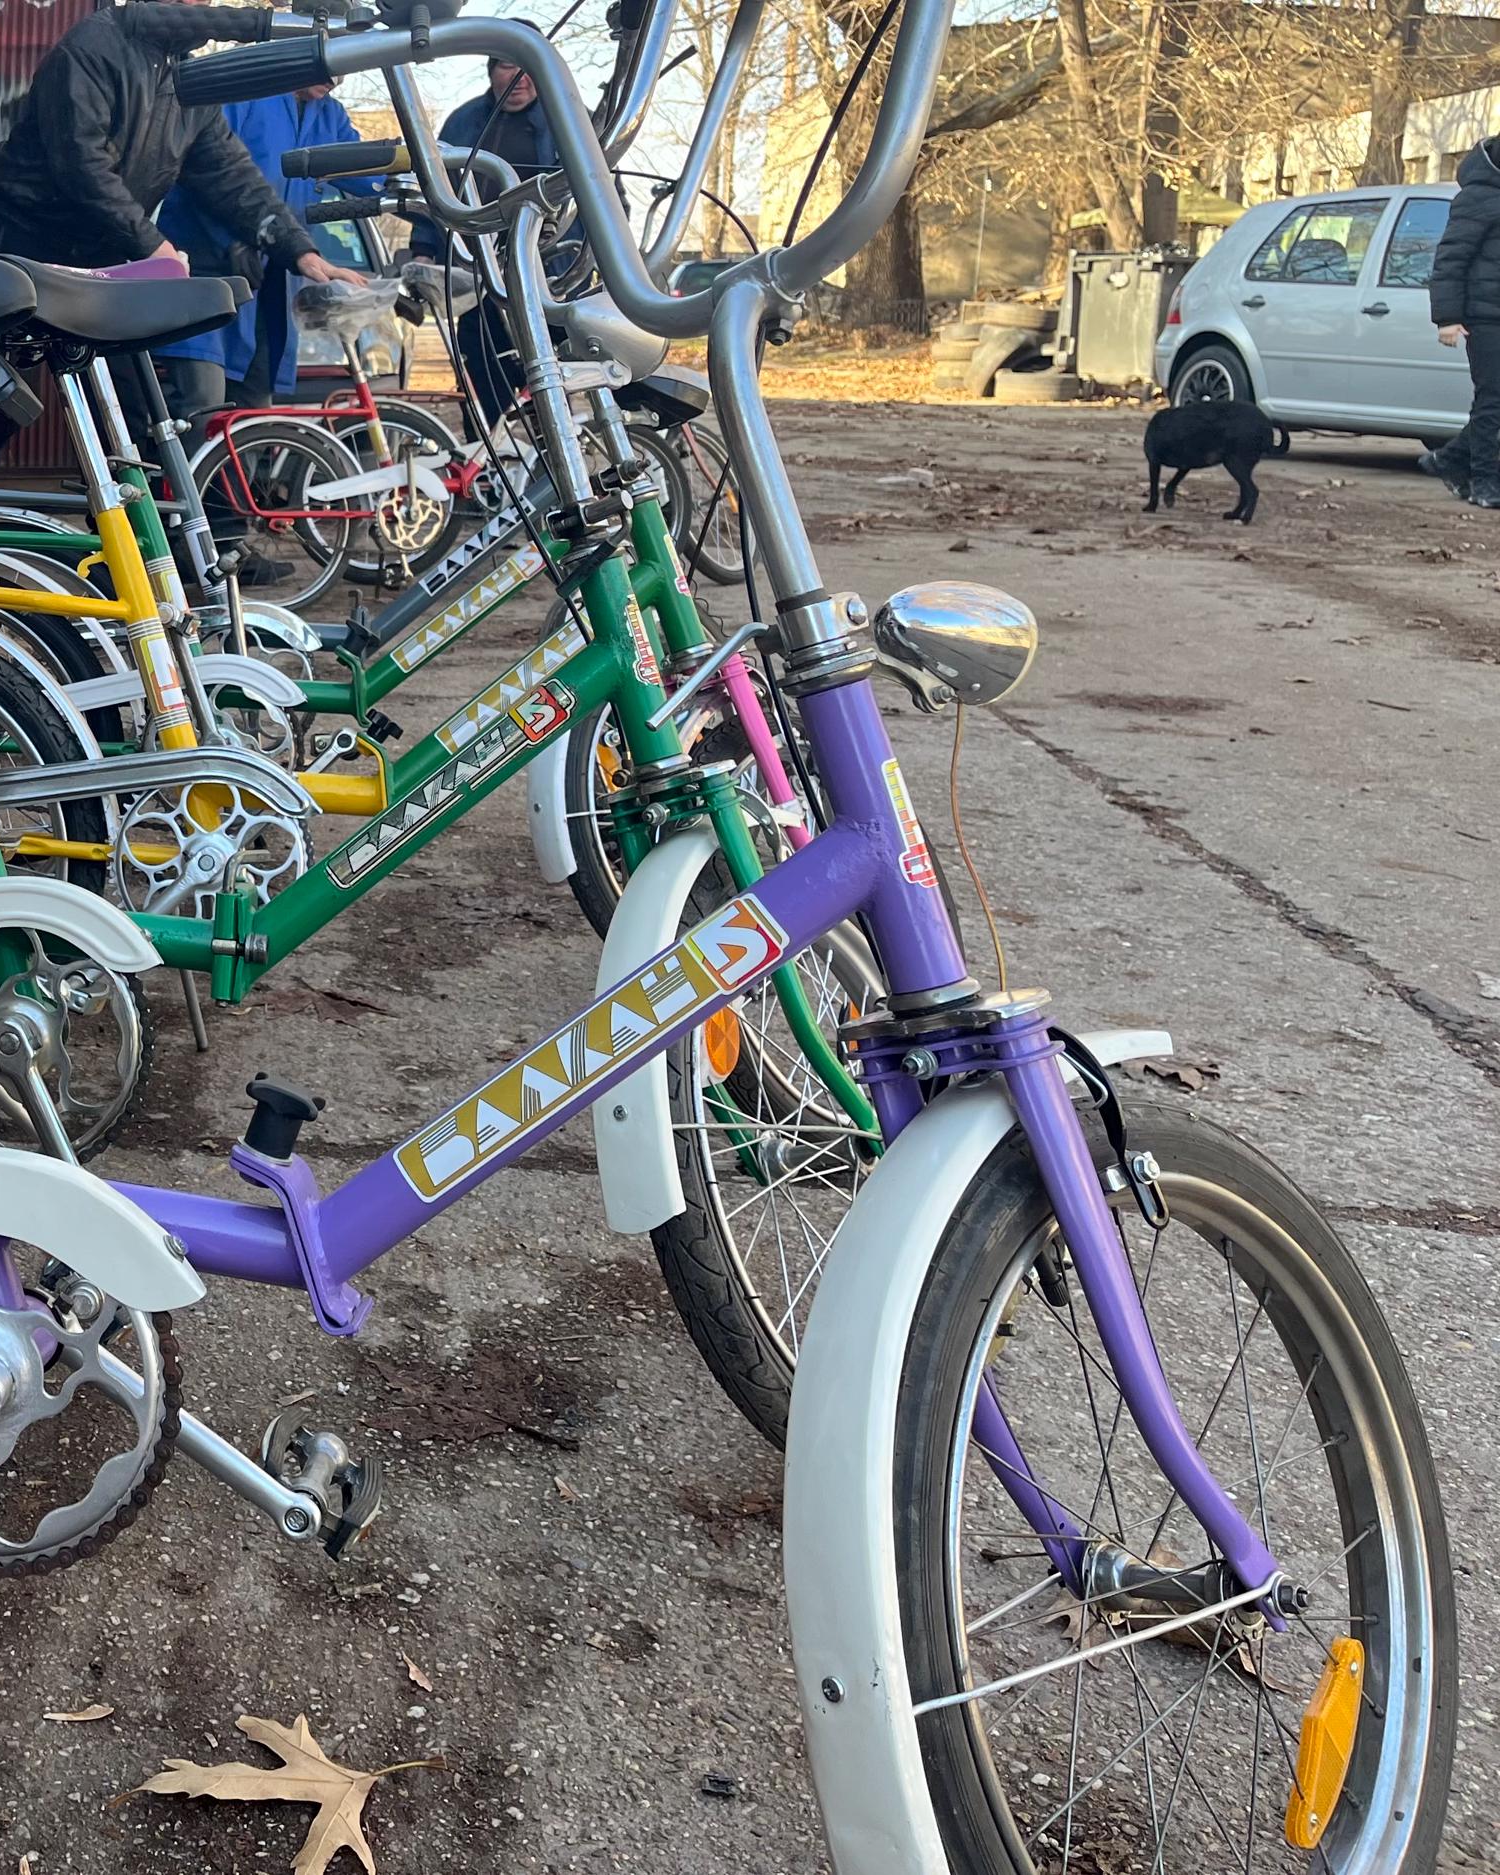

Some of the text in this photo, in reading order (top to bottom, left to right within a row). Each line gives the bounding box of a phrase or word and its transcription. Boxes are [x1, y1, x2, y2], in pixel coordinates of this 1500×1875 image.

[402, 565, 516, 667] БАЛКАН
[449, 621, 586, 749] БАЛКАН
[345, 726, 507, 873] БАЛКАН
[419, 954, 699, 1187] БАЛКАН
